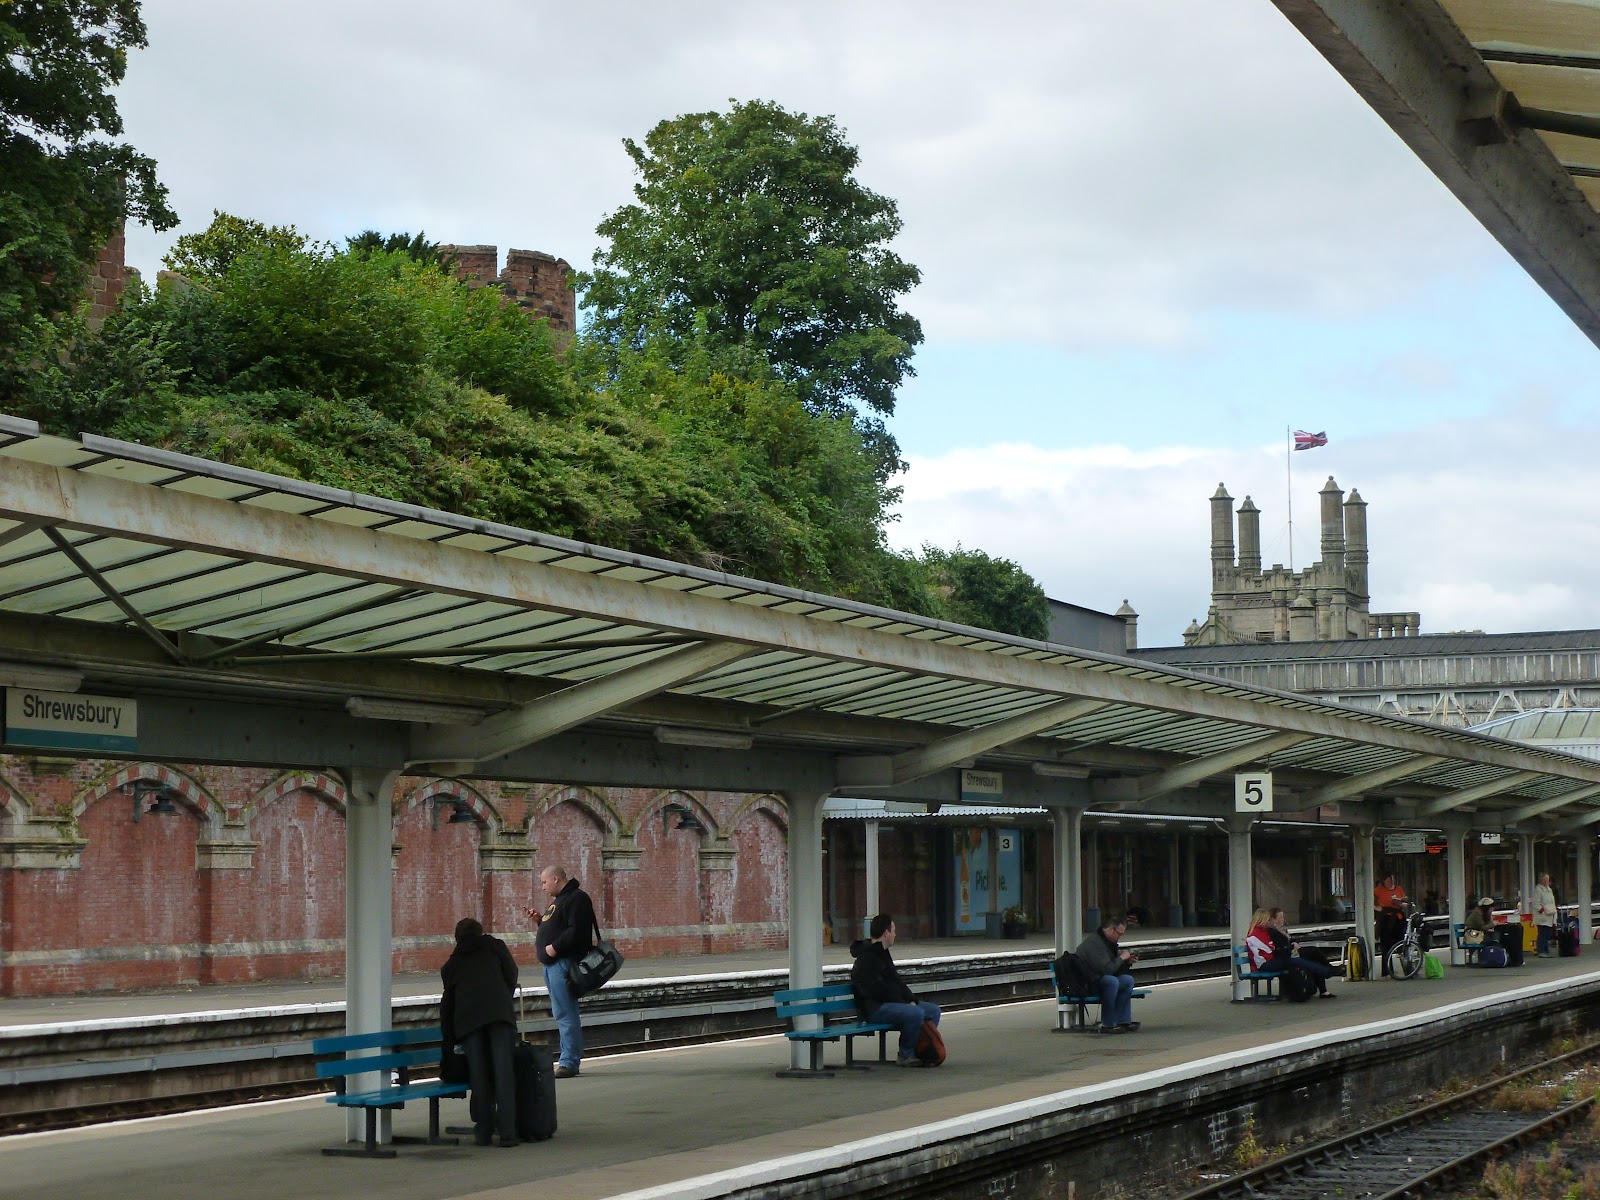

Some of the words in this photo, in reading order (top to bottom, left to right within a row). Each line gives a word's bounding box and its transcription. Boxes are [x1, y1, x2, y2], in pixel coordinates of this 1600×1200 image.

[23, 694, 121, 729] Shrewsbury
[1245, 780, 1263, 805] 5
[1003, 839, 1010, 849] 3
